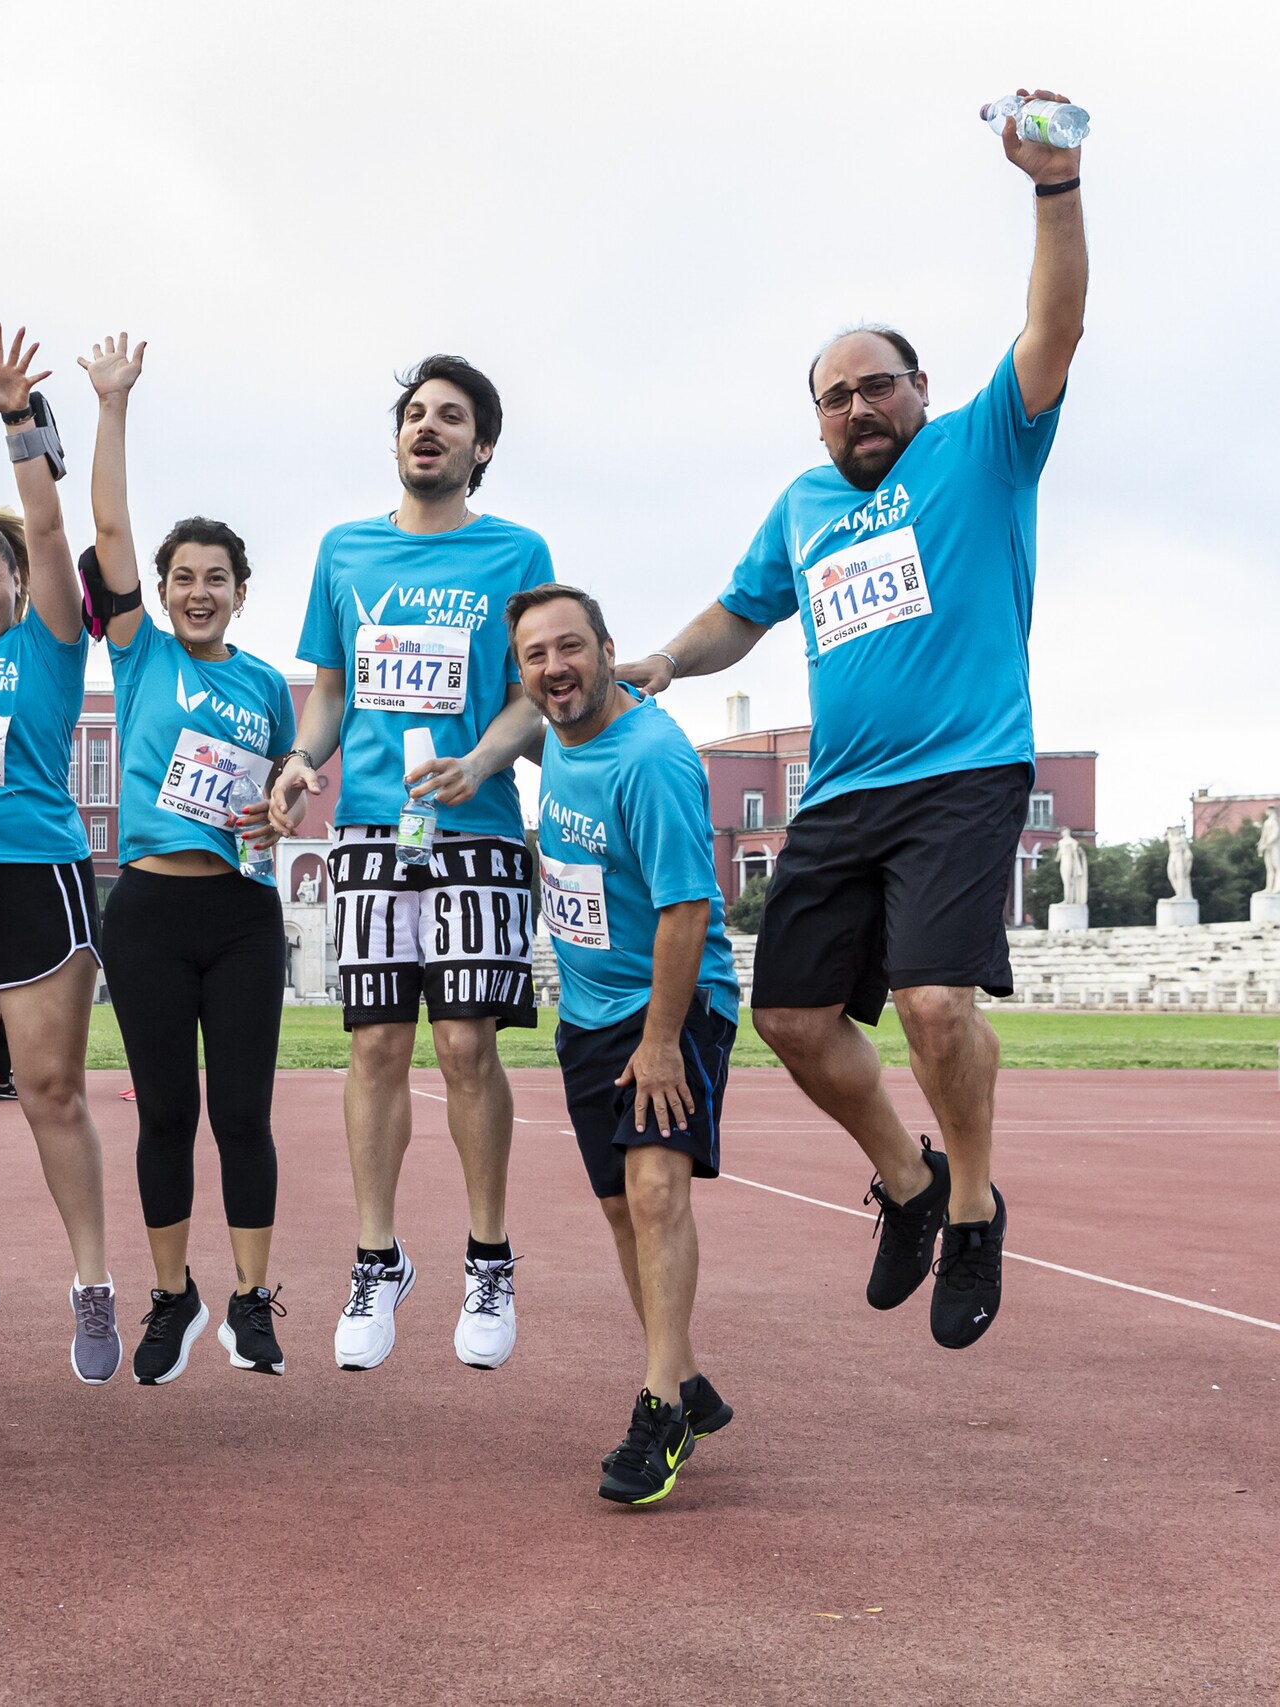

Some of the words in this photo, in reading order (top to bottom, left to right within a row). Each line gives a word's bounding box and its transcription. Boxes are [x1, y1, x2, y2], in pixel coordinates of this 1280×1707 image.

[855, 501, 910, 536] MART
[397, 587, 489, 615] VANTEA
[829, 571, 898, 621] 1143
[425, 608, 487, 631] SMART
[376, 658, 443, 692] 1147
[549, 799, 607, 842] VANTEA
[561, 828, 607, 855] SMART
